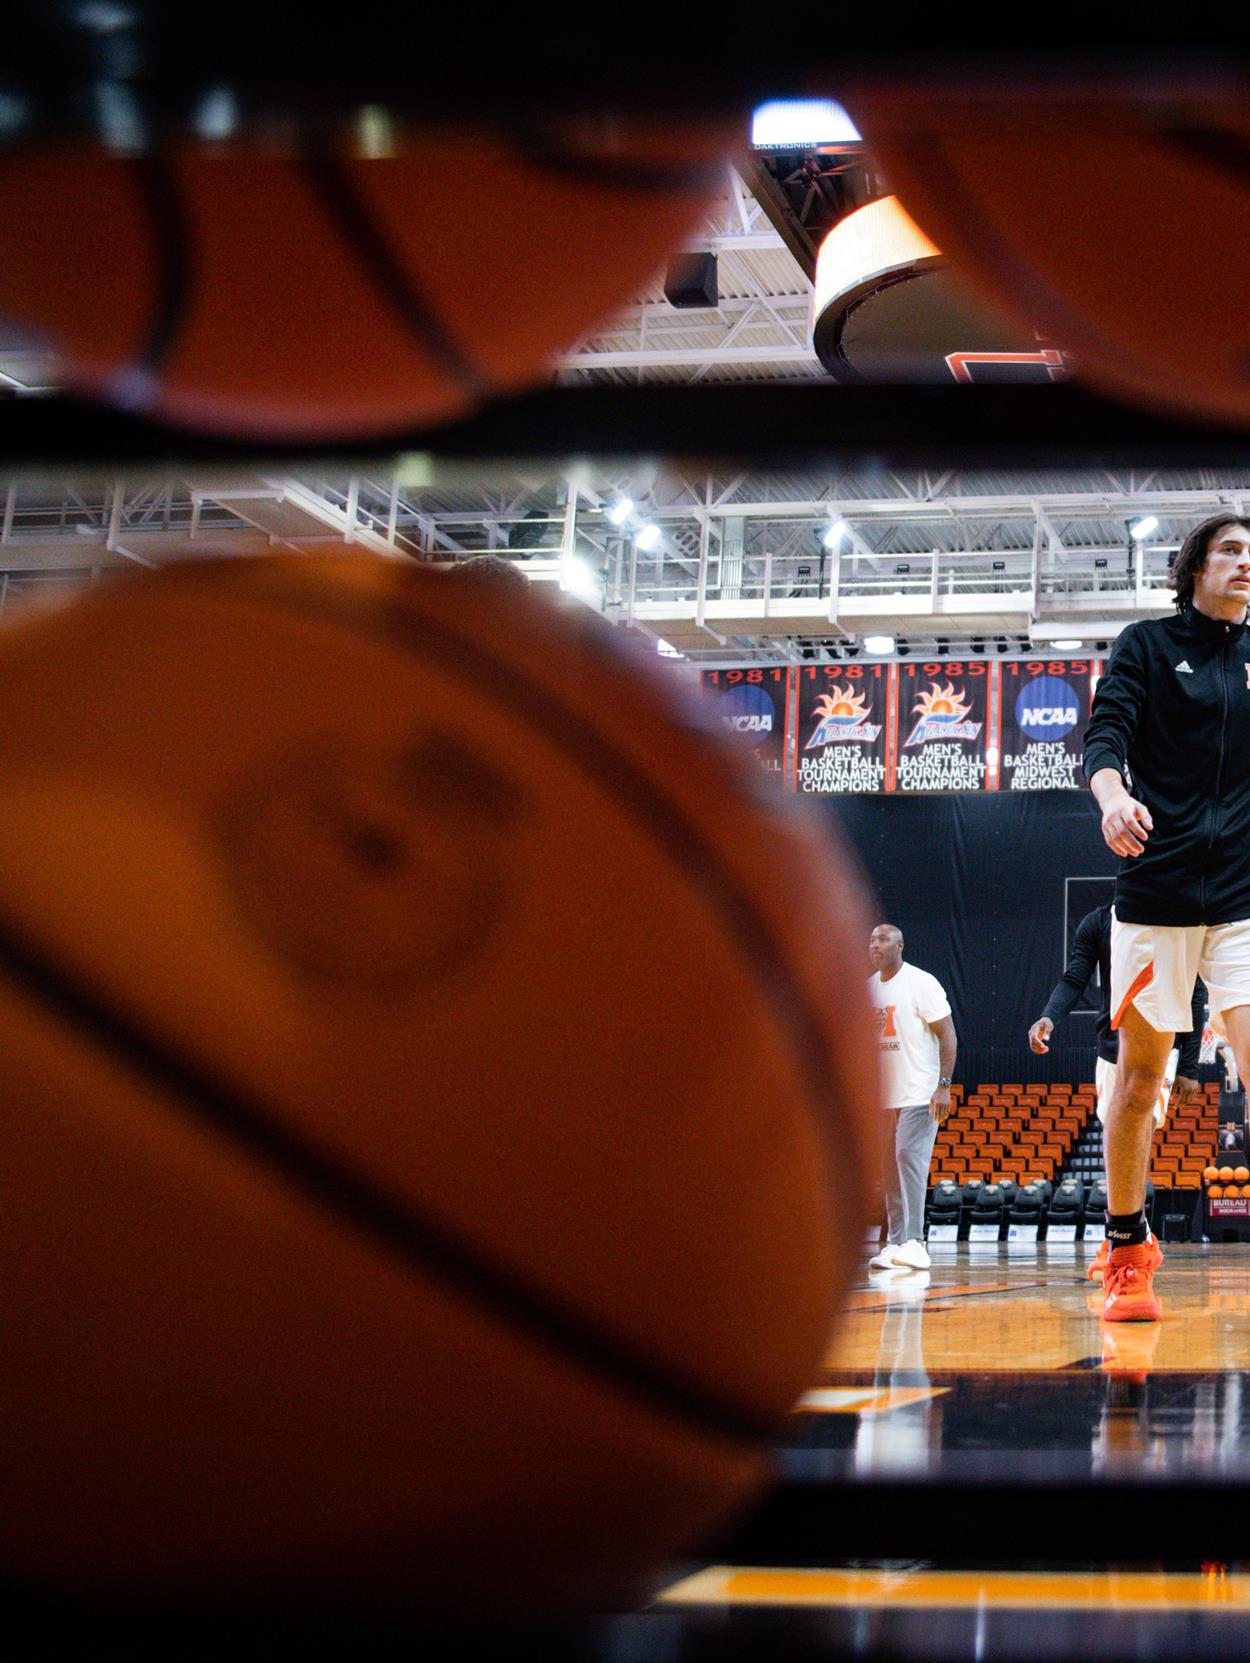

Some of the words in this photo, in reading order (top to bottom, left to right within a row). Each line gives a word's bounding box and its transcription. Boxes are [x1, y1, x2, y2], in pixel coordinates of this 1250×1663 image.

[754, 142, 817, 150] DAKTRONICS
[805, 664, 882, 680] 1981
[904, 662, 986, 677] 1985
[1006, 660, 1088, 677] 1985
[707, 668, 782, 684] 1981
[1021, 707, 1078, 726] NCAA
[823, 745, 862, 758] MEN'S
[922, 743, 962, 756] MEN'S
[1026, 742, 1065, 755] MEN'S
[801, 757, 884, 770] BASKETBALL
[901, 755, 984, 768] BASKETBALL
[797, 768, 886, 781] TOURNAMENT
[896, 766, 986, 779] TOURNAMENT
[1014, 765, 1075, 778] MIDWEST
[803, 780, 880, 792] CHAMPIONS
[902, 778, 980, 790] CHAMPIONS
[1011, 777, 1079, 789] REGIONAL
